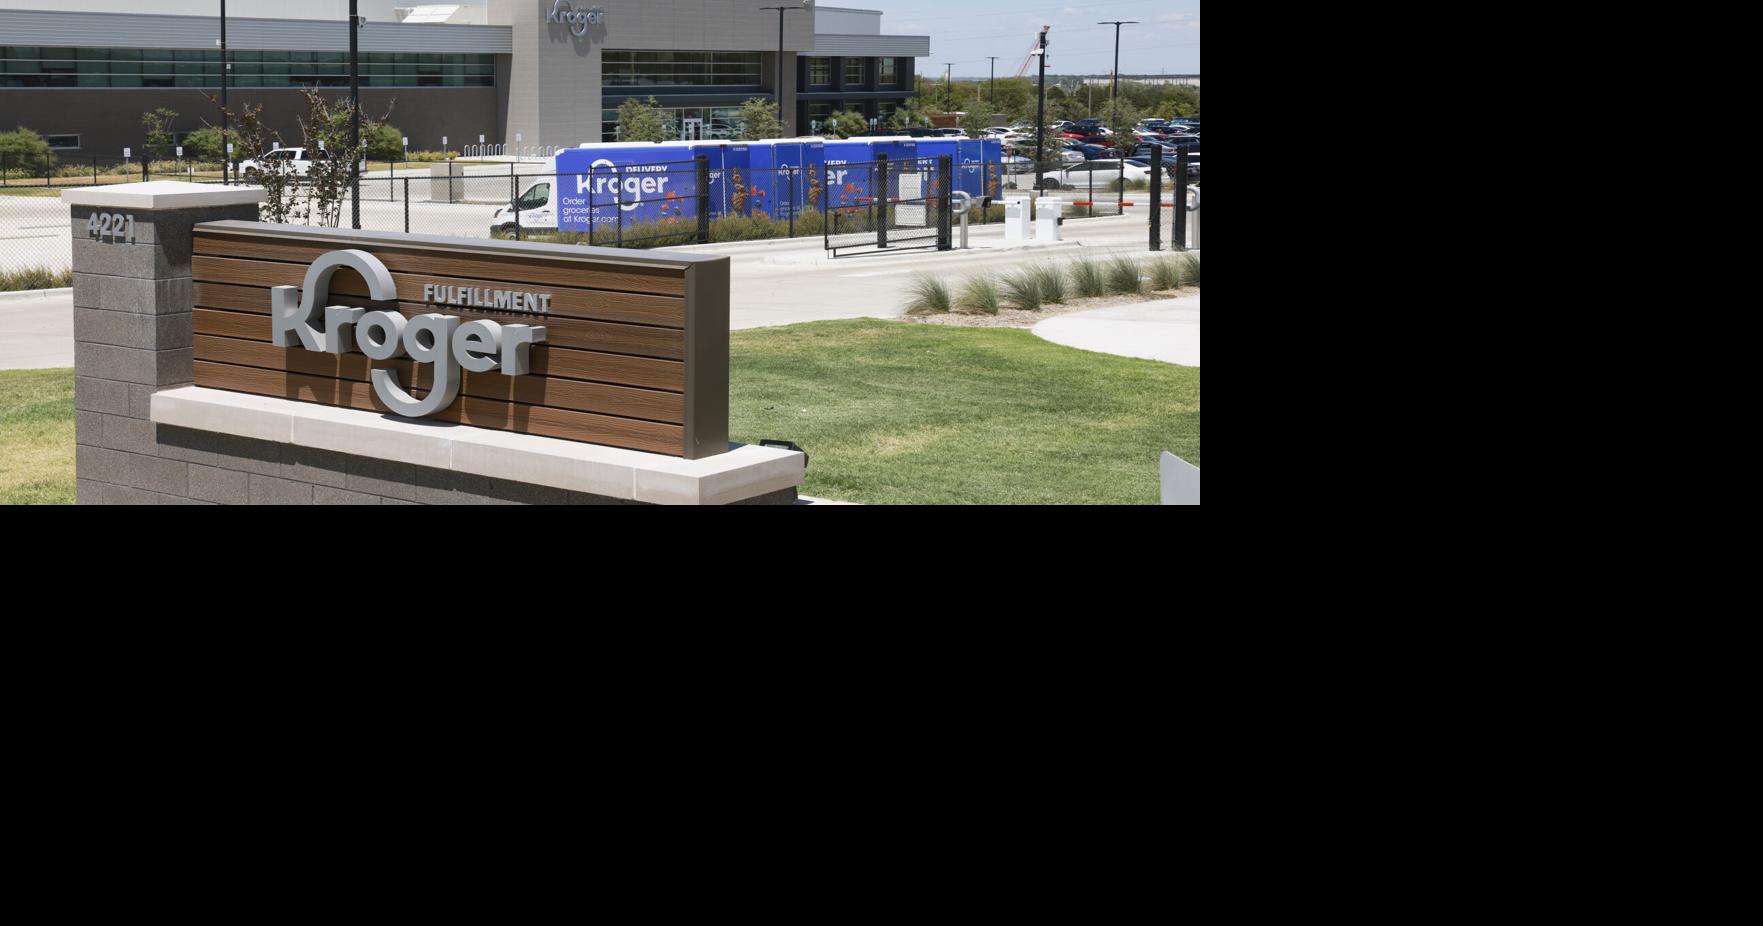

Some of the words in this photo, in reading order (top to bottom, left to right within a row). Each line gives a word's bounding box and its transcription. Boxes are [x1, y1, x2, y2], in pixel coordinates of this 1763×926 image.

[546, 0, 604, 36] Kroger
[576, 158, 669, 211] Kroger
[562, 197, 585, 205] Order
[562, 207, 600, 215] groceres
[88, 211, 136, 242] 4221
[423, 283, 552, 314] FULFILLMENT
[271, 248, 547, 418] Kroger
